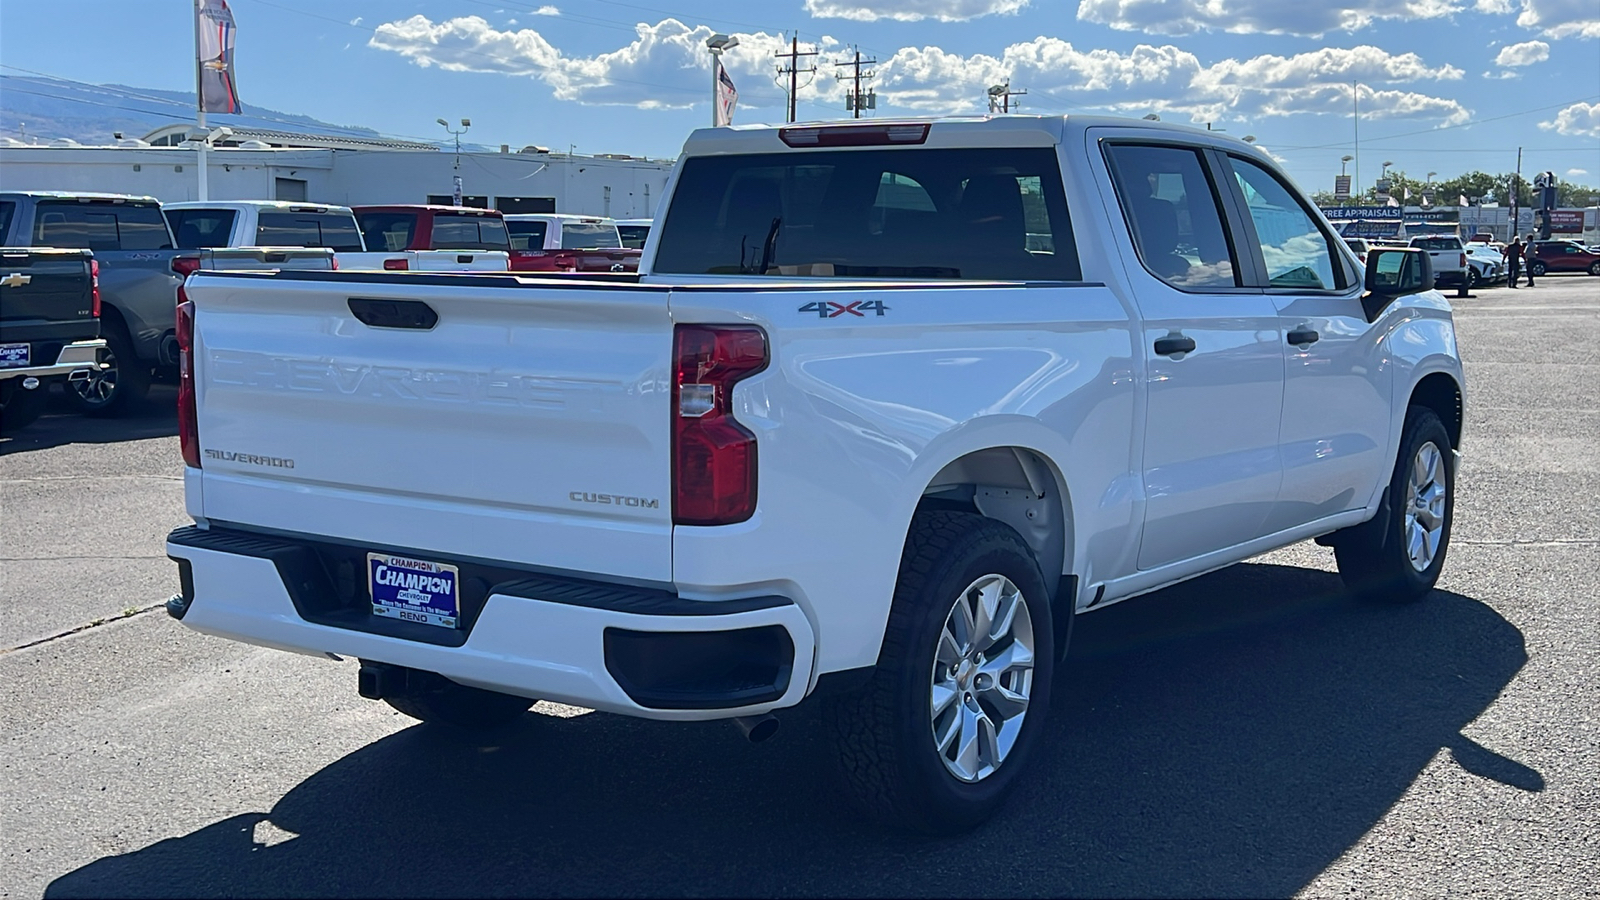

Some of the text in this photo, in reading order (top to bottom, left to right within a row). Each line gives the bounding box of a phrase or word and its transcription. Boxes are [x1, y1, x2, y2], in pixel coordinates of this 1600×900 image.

[1322, 208, 1400, 218] FREE APPRAISALS!
[0, 347, 28, 355] CHAMPION
[208, 352, 622, 412] CHEVROLET
[204, 448, 295, 469] SILVERADO
[569, 491, 659, 509] CUSTOM
[391, 557, 433, 572] CHAMPION
[375, 565, 452, 595] CHAMPION
[399, 590, 430, 603] CHEVROLET
[400, 611, 428, 623] RENO
